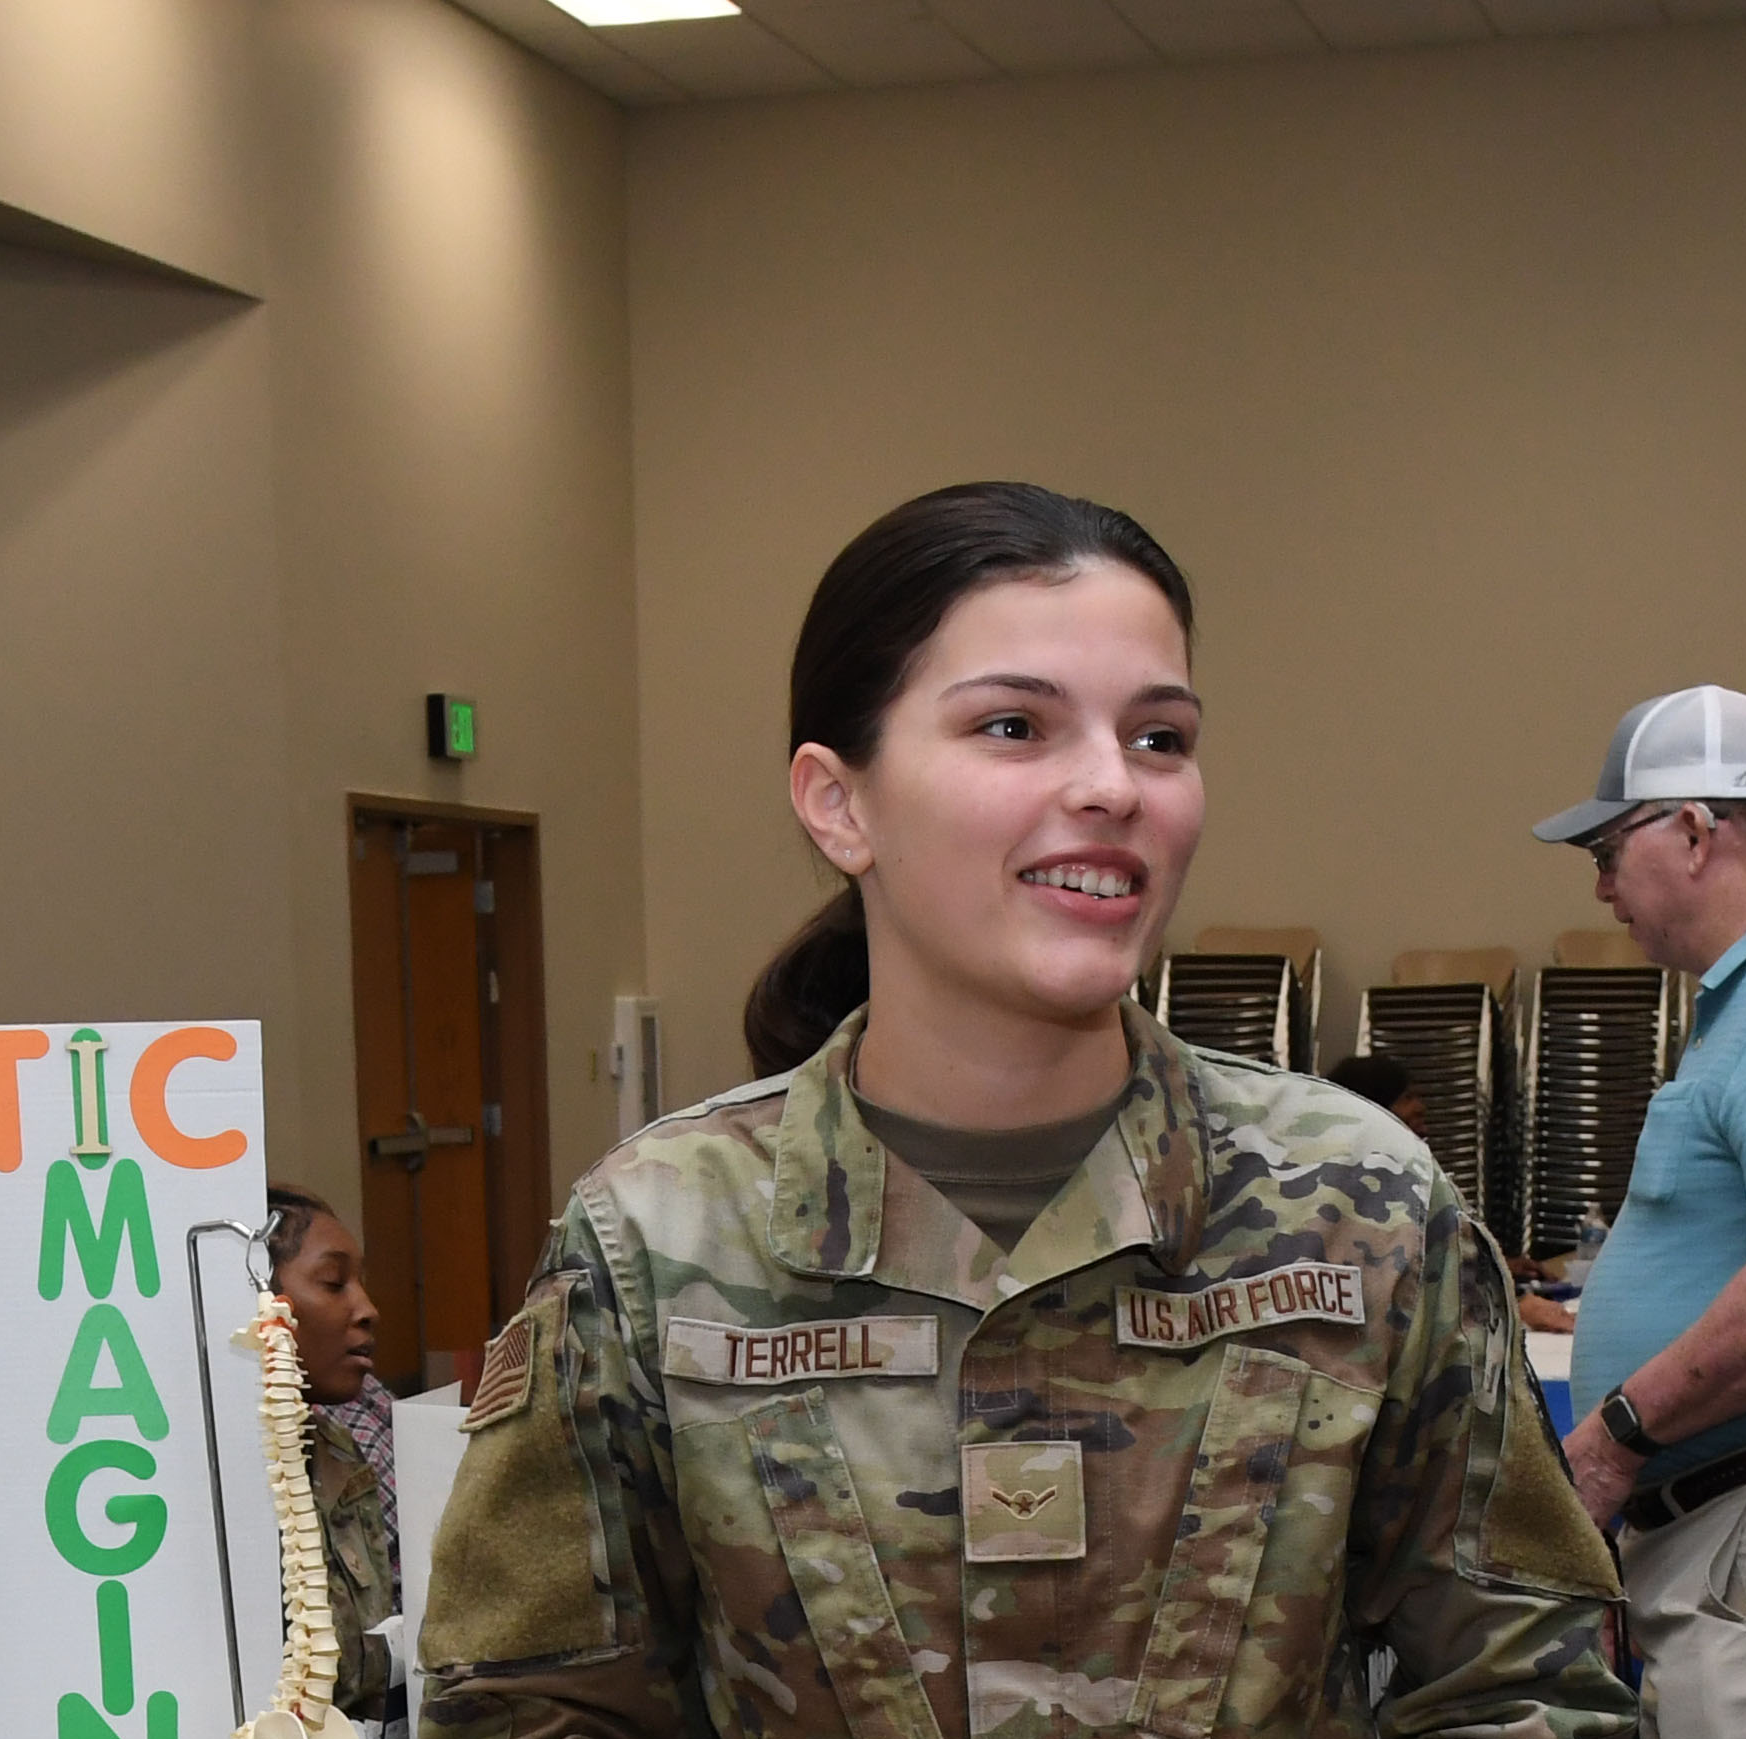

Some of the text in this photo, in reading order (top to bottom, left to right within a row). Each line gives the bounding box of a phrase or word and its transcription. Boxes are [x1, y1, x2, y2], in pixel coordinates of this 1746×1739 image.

[1128, 1264, 1357, 1344] U.S. AIR FORCE
[725, 1323, 884, 1379] TERRELL
